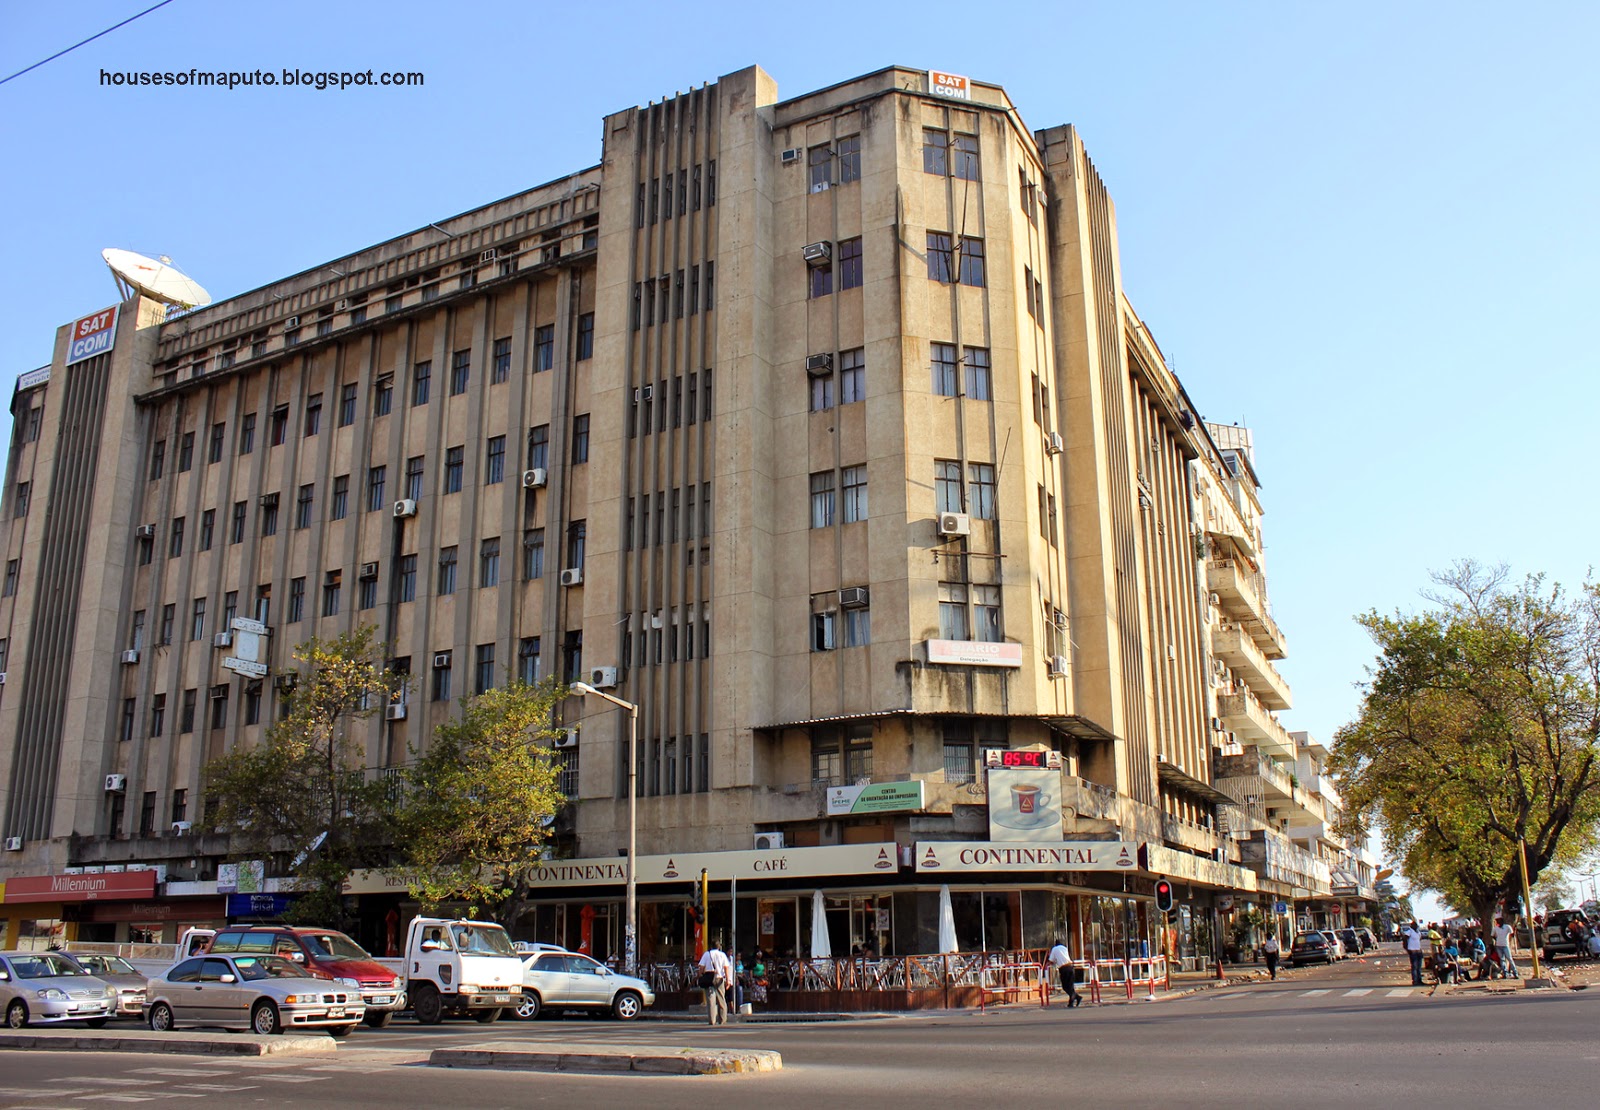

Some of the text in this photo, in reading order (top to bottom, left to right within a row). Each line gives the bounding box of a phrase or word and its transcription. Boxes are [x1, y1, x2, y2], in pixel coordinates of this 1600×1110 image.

[938, 74, 962, 87] SAT
[936, 85, 964, 99] COM
[80, 312, 110, 336] SAT
[74, 331, 108, 357] COM
[1004, 752, 1021, 767] 85
[753, 856, 788, 872] CAFÉ
[960, 848, 1099, 865] CONTINENTAL
[528, 862, 630, 882] CONTINENTA
[51, 876, 106, 891] Millennium
[132, 904, 171, 914] Millennium
